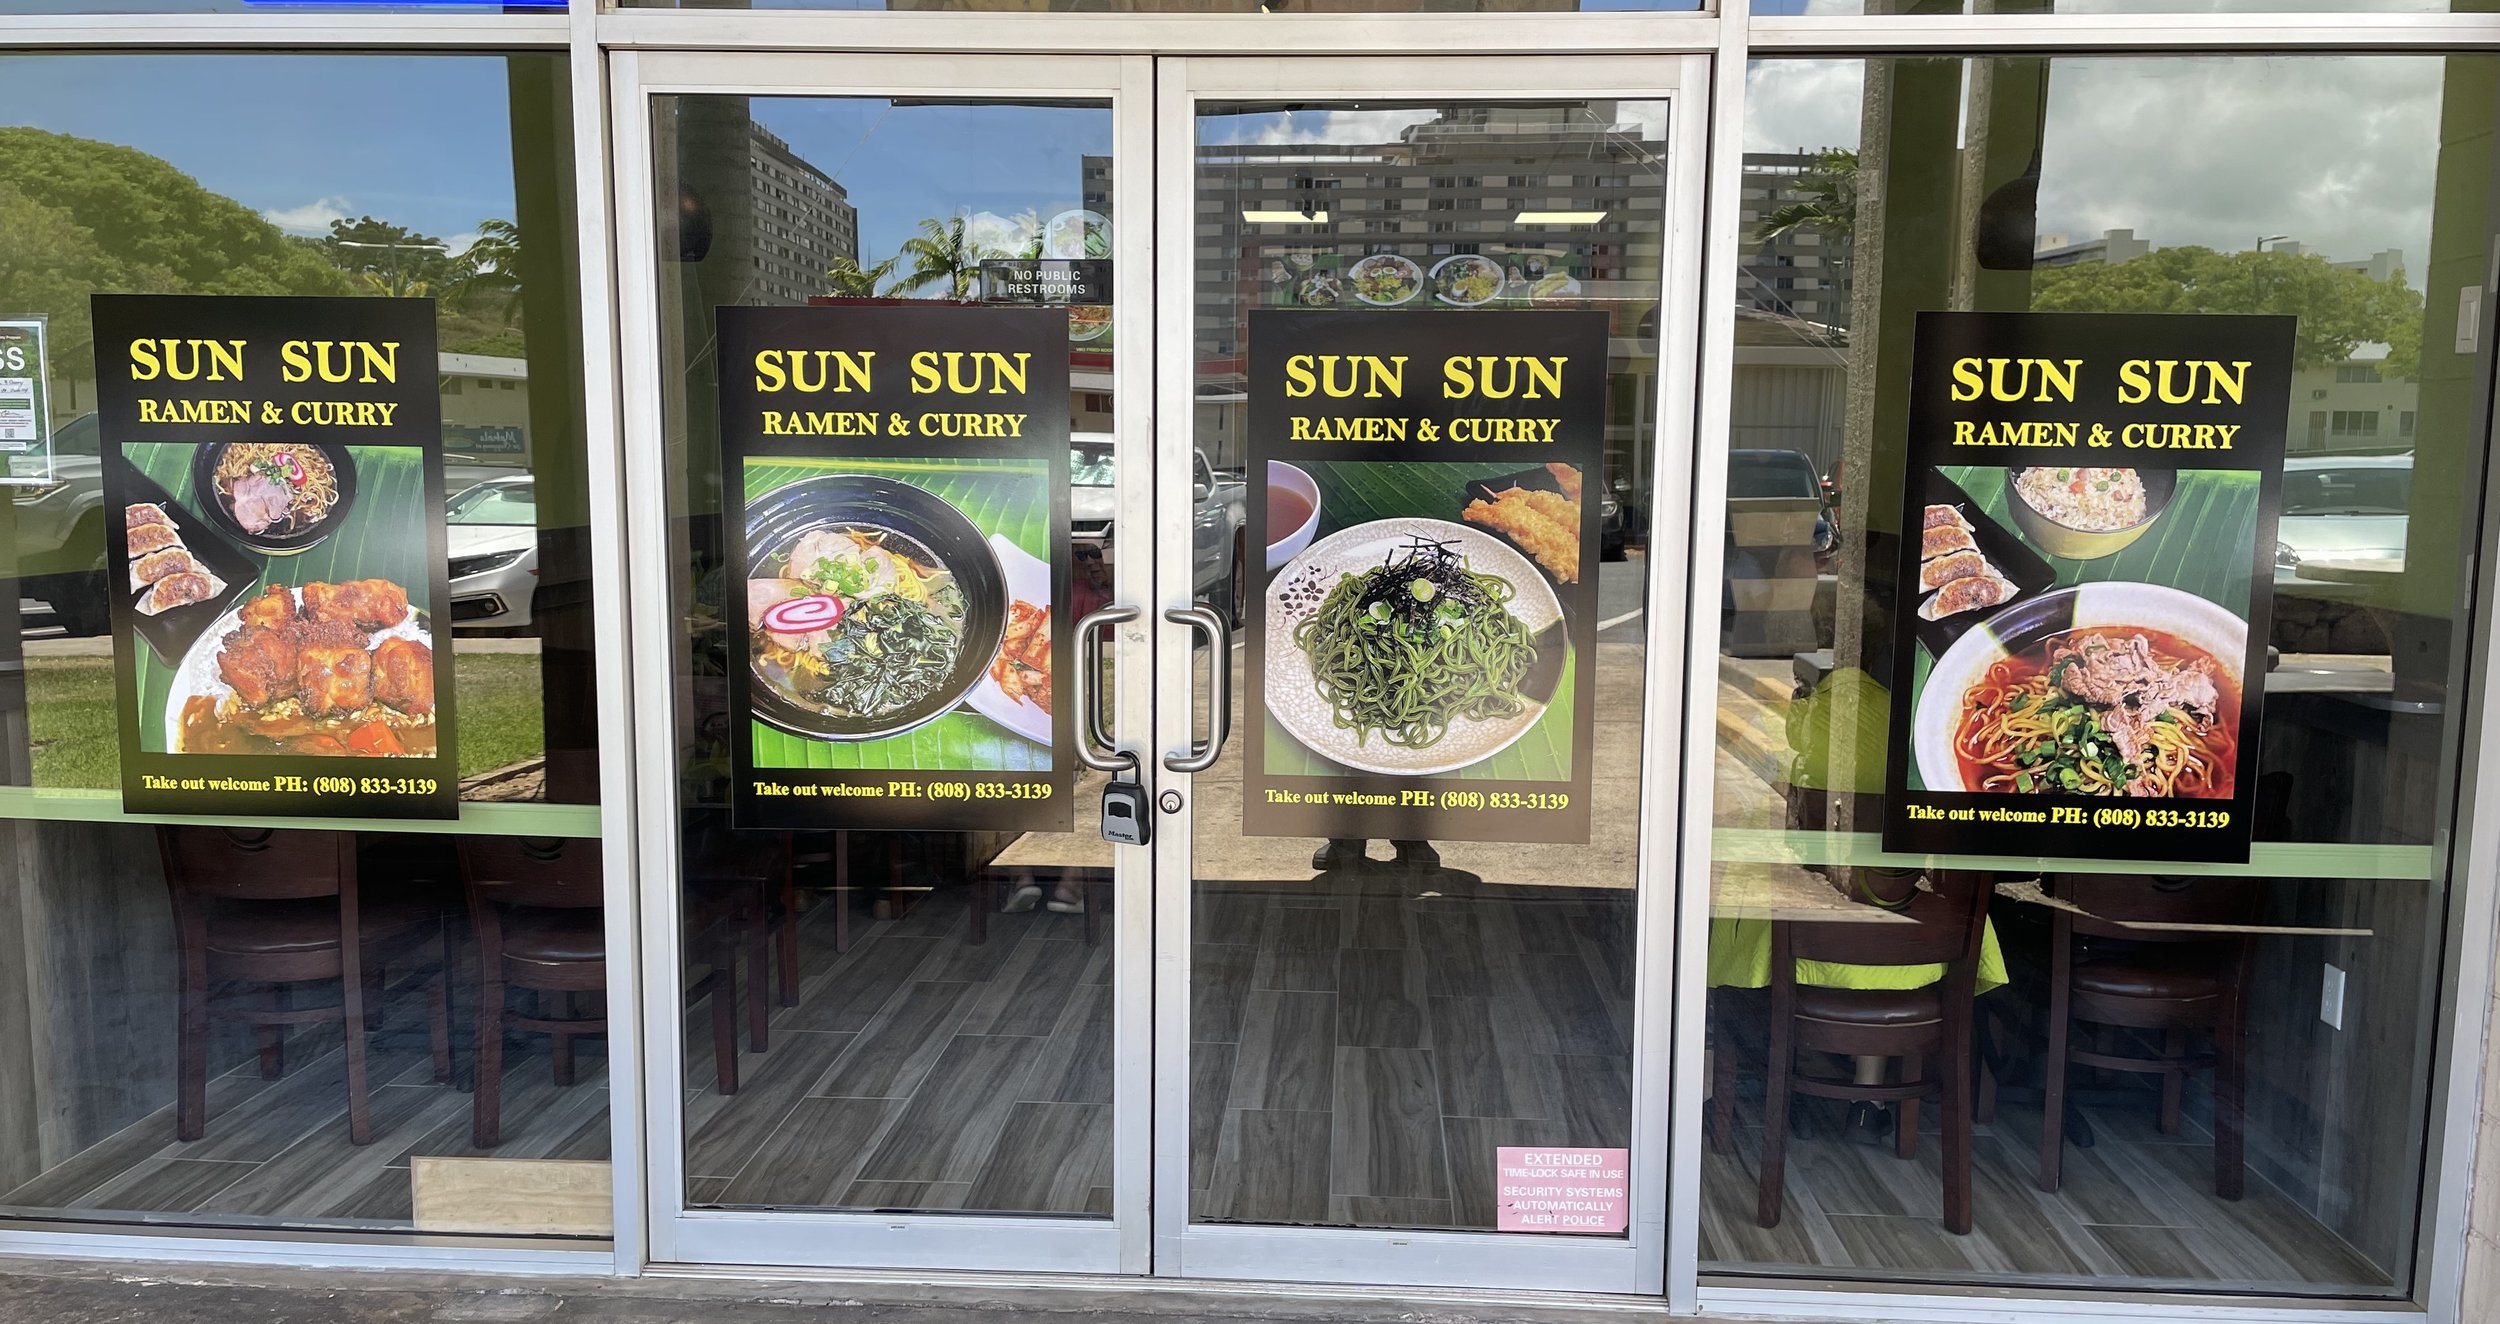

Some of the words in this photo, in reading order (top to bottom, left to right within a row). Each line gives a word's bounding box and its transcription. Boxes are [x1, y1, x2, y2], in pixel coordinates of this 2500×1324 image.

[1014, 271, 1032, 281] NO
[1036, 271, 1081, 281] PUBLIC
[1008, 284, 1086, 294] RESTROOMS
[130, 338, 246, 381] SUN
[281, 340, 399, 383] SUN
[755, 350, 875, 393] SUN
[911, 351, 1030, 394] SUN
[1285, 354, 1408, 398] SUN
[1443, 356, 1567, 399] SUN
[1951, 357, 2082, 402] SUN
[2118, 359, 2251, 404] SUN
[140, 399, 251, 424] RAMEN
[261, 401, 282, 424] &
[291, 401, 396, 426] CURRY
[763, 411, 877, 436] RAMEN
[888, 413, 909, 436] &
[919, 413, 1024, 437] CURRY
[1292, 416, 1408, 441] RAMEN
[1417, 418, 1439, 442] &
[1448, 418, 1558, 443] CURRY
[1954, 421, 2079, 447] RAMEN
[2088, 423, 2111, 448] &
[2121, 423, 2238, 449] CURRY
[142, 775, 177, 791] Take
[180, 777, 206, 792] out
[208, 776, 270, 793] welcome
[274, 775, 309, 793] PH:
[312, 775, 357, 796] (808)
[360, 777, 437, 795] 833-3139
[754, 781, 790, 797] Take
[793, 784, 817, 797] out
[821, 783, 883, 798] welcome
[888, 781, 922, 798] PH:
[926, 782, 971, 801] (808)
[975, 783, 1052, 799] 833-3139
[1265, 790, 1301, 804] Take
[1305, 792, 1329, 804] out
[1333, 792, 1396, 806] welcome
[1401, 790, 1435, 807] PH:
[1440, 792, 1485, 810] (808)
[1490, 793, 1568, 809] 833-3139
[1907, 804, 1945, 820] Take
[1948, 808, 1974, 821] out
[1979, 807, 2046, 823] welcome
[2051, 807, 2088, 824] PH:
[2093, 809, 2141, 828] (808)
[2145, 810, 2230, 828] 833-3139
[1108, 830, 1133, 839] Master
[1524, 1153, 1603, 1166] EXTENDED
[1503, 1168, 1558, 1178] TIME-LOCK
[1560, 1169, 1587, 1178] SAFE
[1589, 1170, 1600, 1178] IN
[1602, 1169, 1624, 1179] USE
[1503, 1186, 1562, 1197] SECURITY
[1566, 1187, 1623, 1198] SYSTEMS
[1513, 1200, 1613, 1212] AUTOMATICALLY
[1521, 1215, 1559, 1225] ALERT
[1562, 1215, 1605, 1225] POLICE
